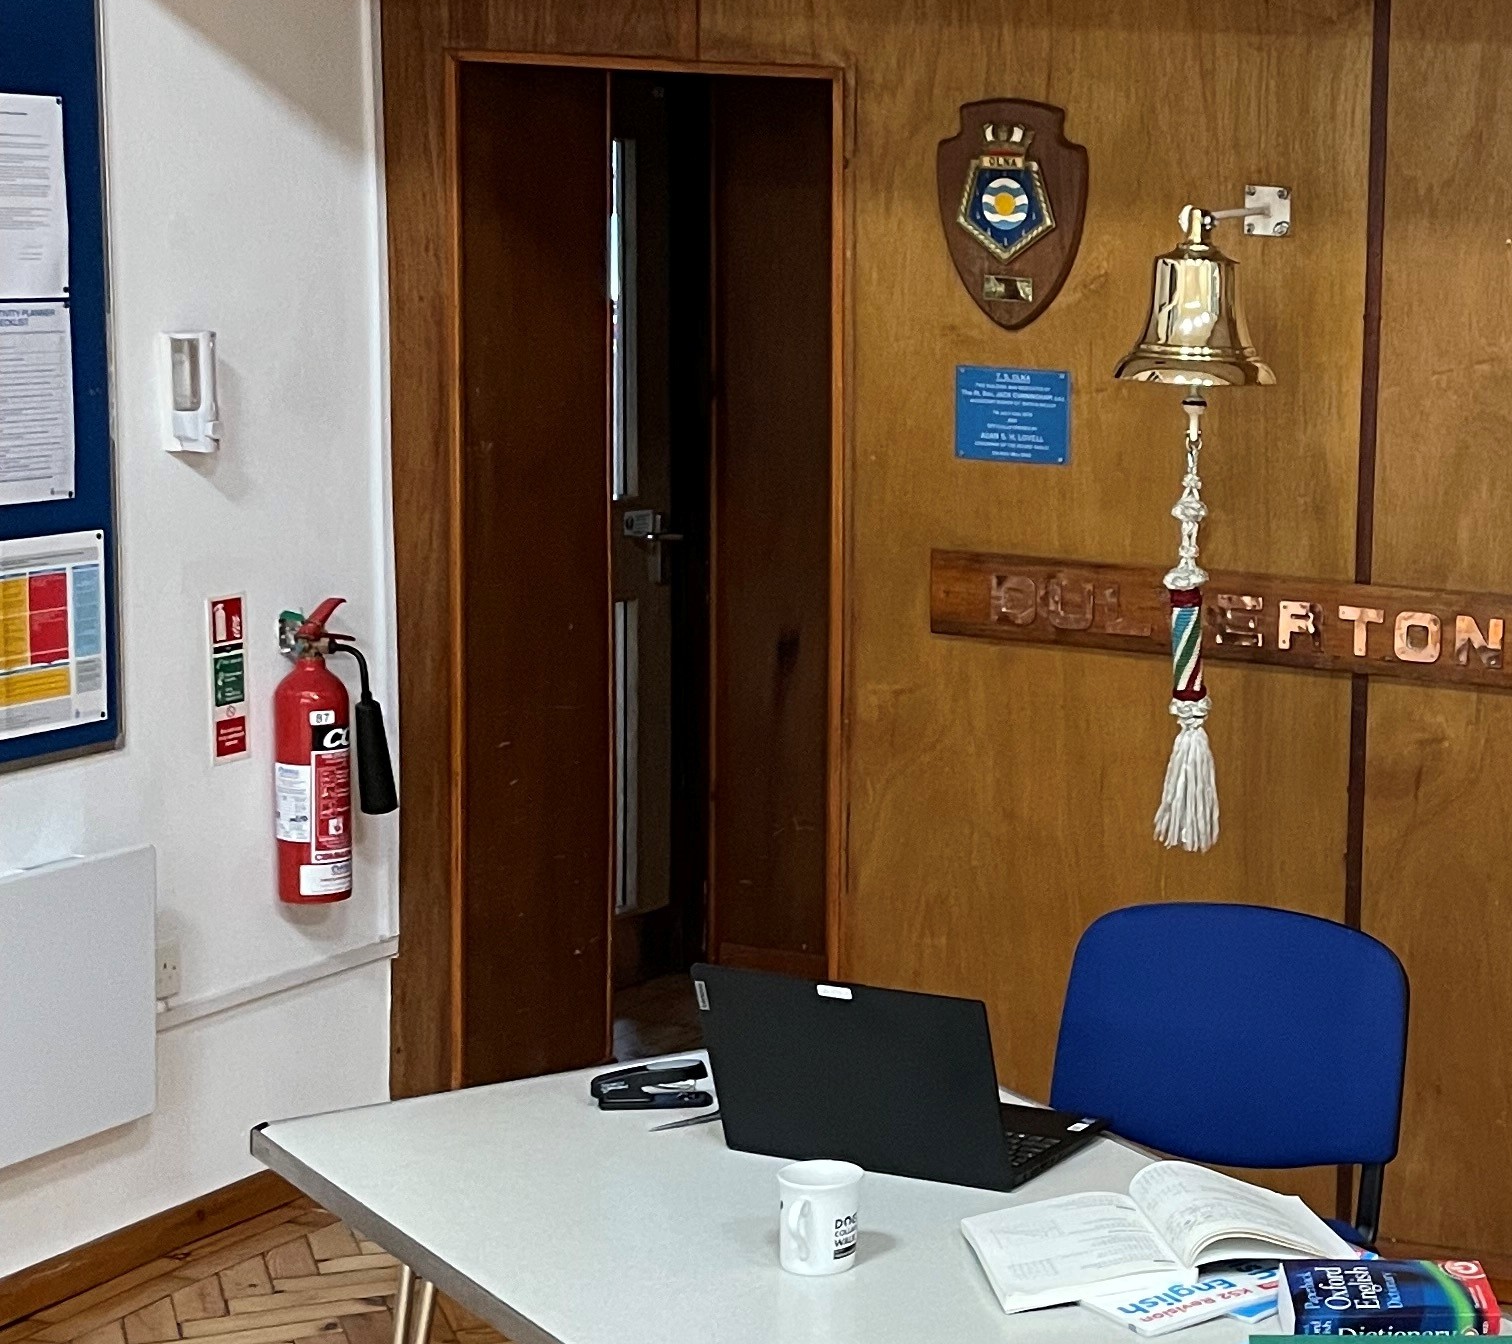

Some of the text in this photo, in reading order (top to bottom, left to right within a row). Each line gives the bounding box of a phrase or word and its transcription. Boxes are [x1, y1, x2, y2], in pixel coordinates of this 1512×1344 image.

[988, 157, 1018, 167] OLNA
[989, 573, 1505, 669] DULERTON
[1117, 1278, 1238, 1315] English
[1140, 1287, 1254, 1323] KS2 Revision
[1314, 1265, 1352, 1311] Oxford
[1344, 1265, 1383, 1310] English
